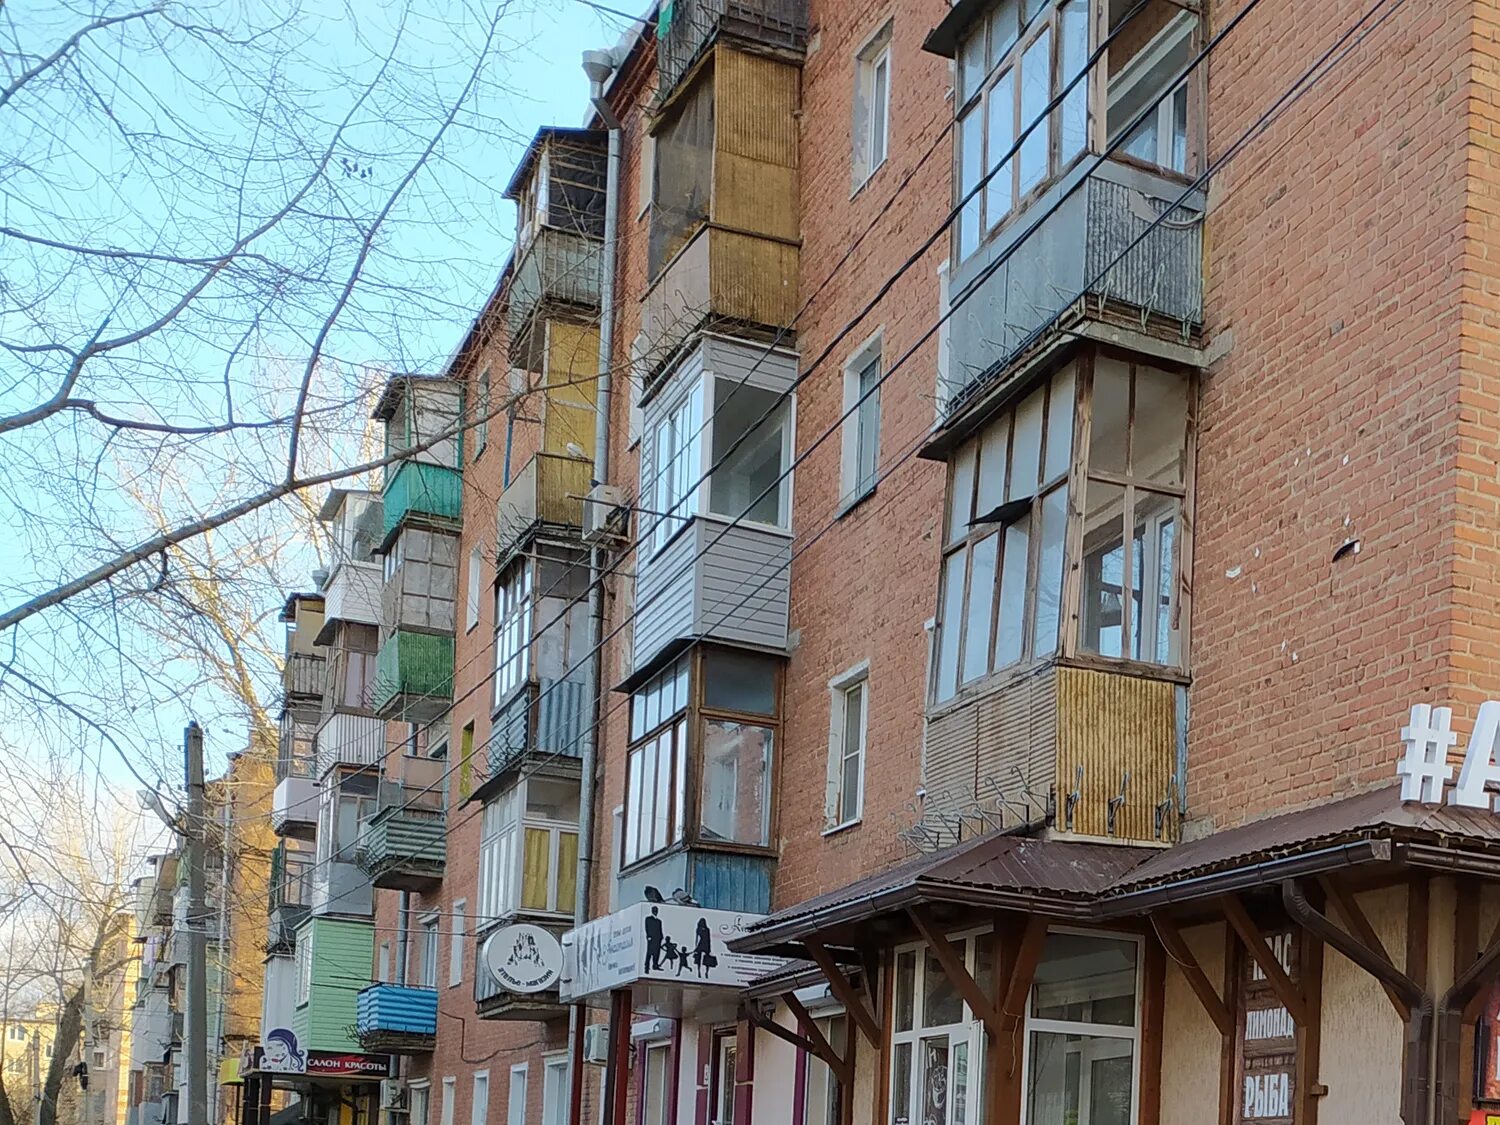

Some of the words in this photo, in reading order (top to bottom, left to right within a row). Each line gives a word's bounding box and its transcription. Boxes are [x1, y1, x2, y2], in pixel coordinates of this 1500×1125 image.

[307, 1058, 341, 1068] САЛОН
[344, 1060, 387, 1071] КРАСОТЫ
[1243, 1072, 1289, 1118] РЫБА
